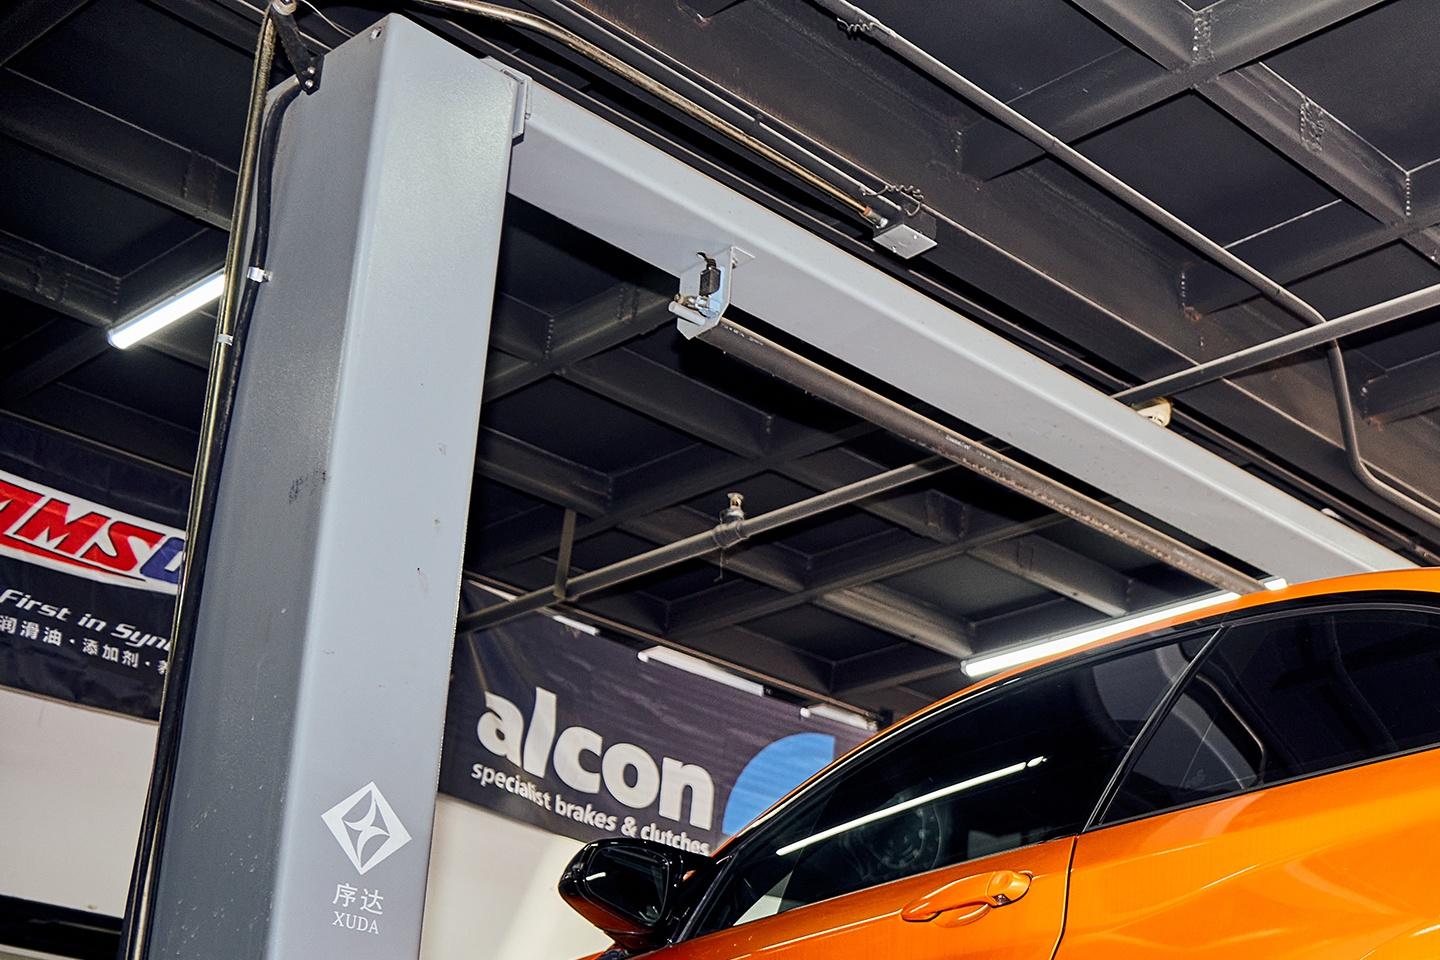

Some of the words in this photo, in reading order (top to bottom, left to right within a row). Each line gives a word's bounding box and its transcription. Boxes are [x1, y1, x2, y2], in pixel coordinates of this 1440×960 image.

[0, 589, 72, 622] First
[78, 613, 107, 632] in
[477, 686, 715, 831] alcon
[471, 761, 552, 811] specialist
[555, 793, 617, 832] brakes
[621, 815, 638, 838] &
[640, 822, 711, 856] clutches
[332, 882, 384, 915] 序达
[332, 911, 380, 935] XUDA
